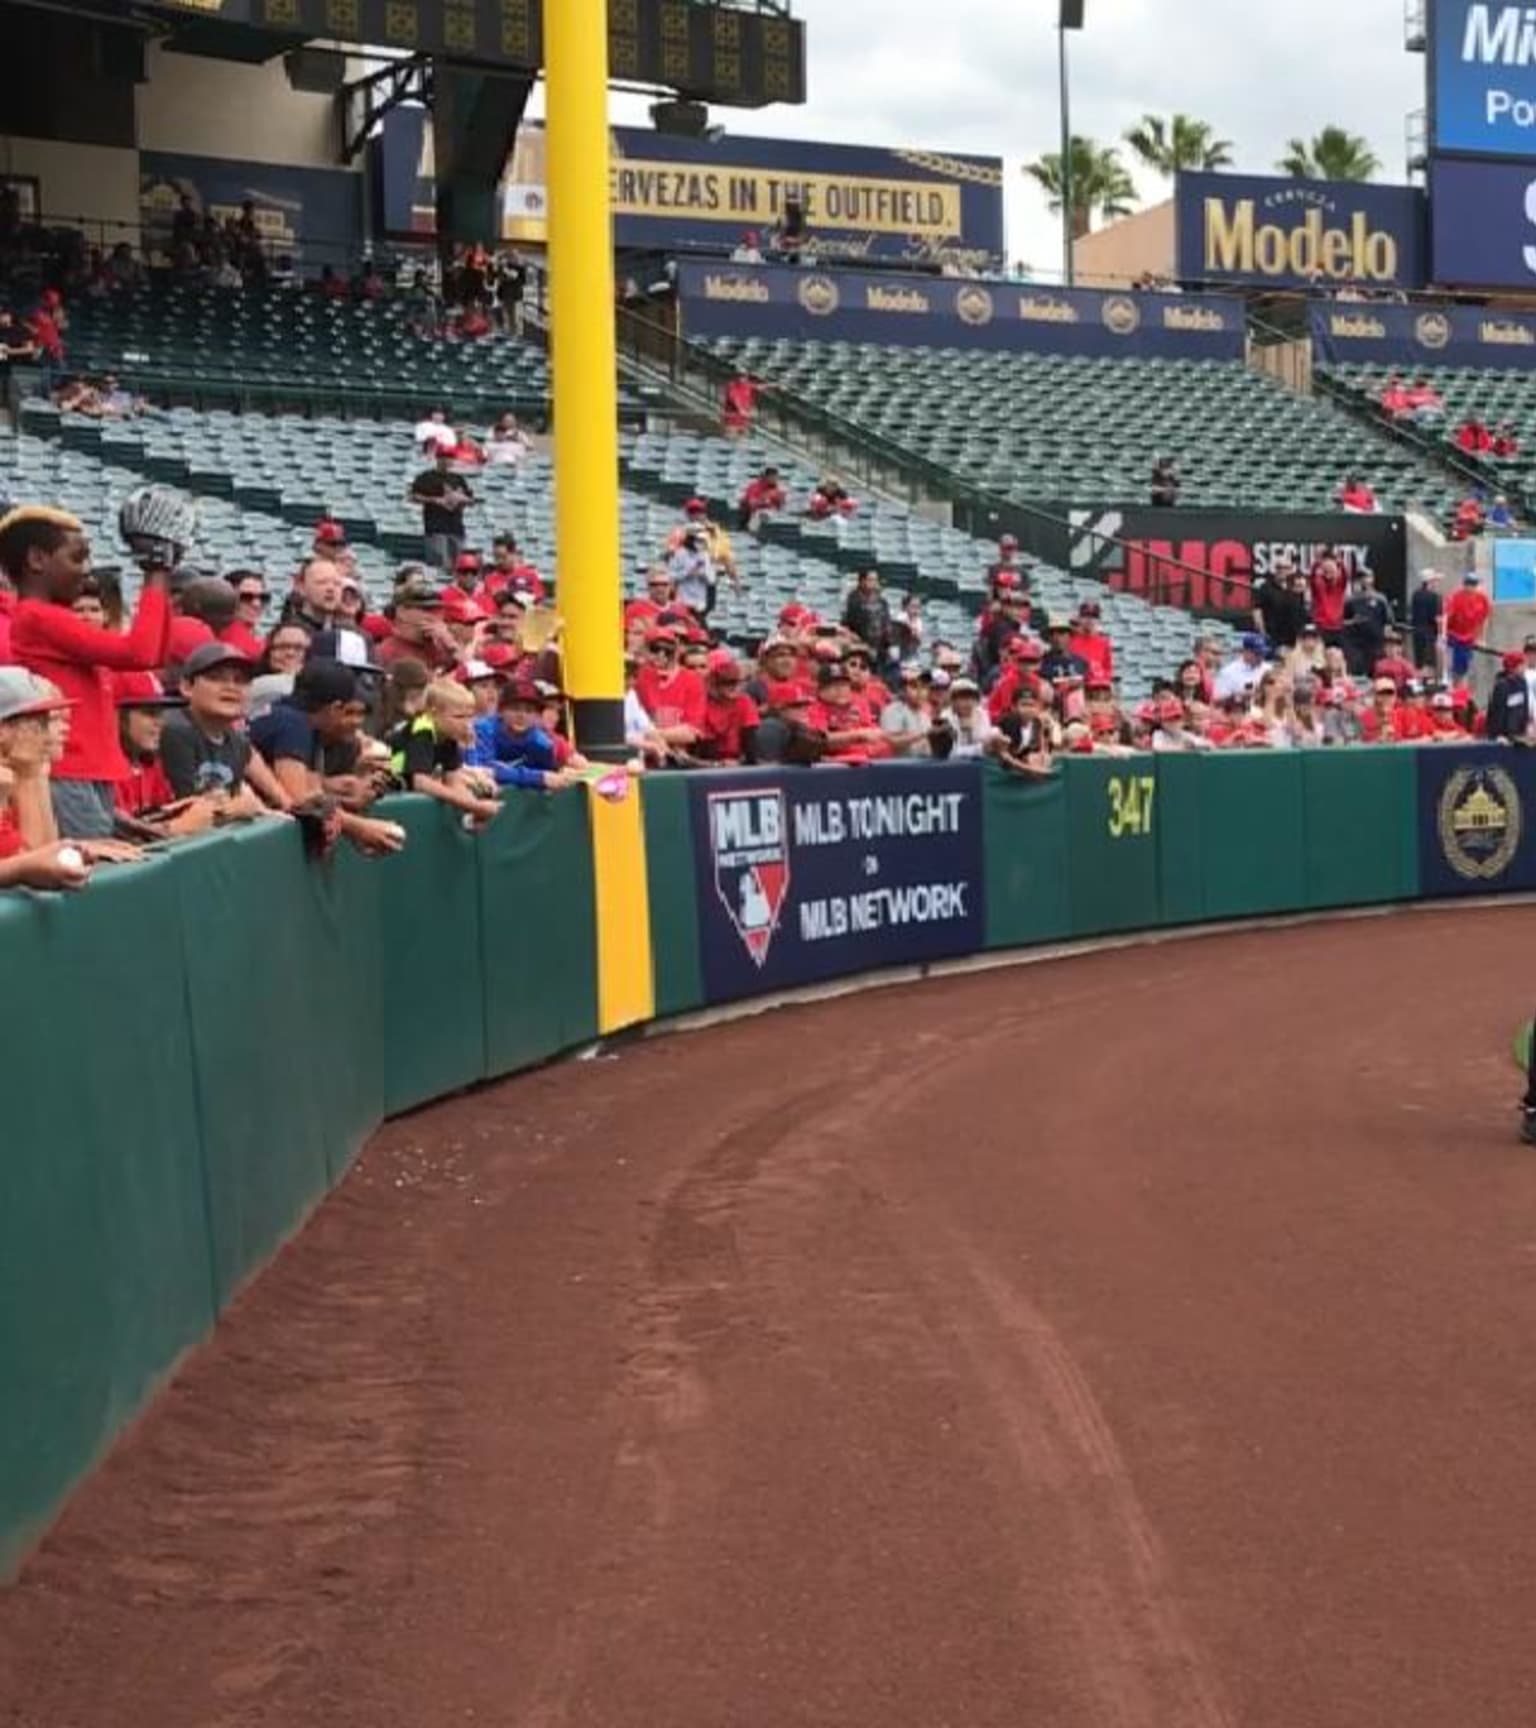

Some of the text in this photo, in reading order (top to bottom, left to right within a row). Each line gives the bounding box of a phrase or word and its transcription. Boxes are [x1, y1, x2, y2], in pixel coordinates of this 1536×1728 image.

[609, 168, 719, 210] ERVEZAS
[729, 177, 757, 212] IN
[826, 184, 953, 227] OUTFIELD.
[1204, 197, 1397, 281] Modelo
[704, 275, 769, 303] Modelo
[867, 286, 930, 313] Modelo
[1019, 298, 1079, 323] Modelo
[1163, 306, 1224, 331] Modelo
[1330, 315, 1386, 338] Modelo
[716, 799, 779, 850] MLB
[795, 793, 963, 845] MLB TONIGHT
[1107, 776, 1155, 838] 347
[800, 883, 965, 940] MLB NETWORK
